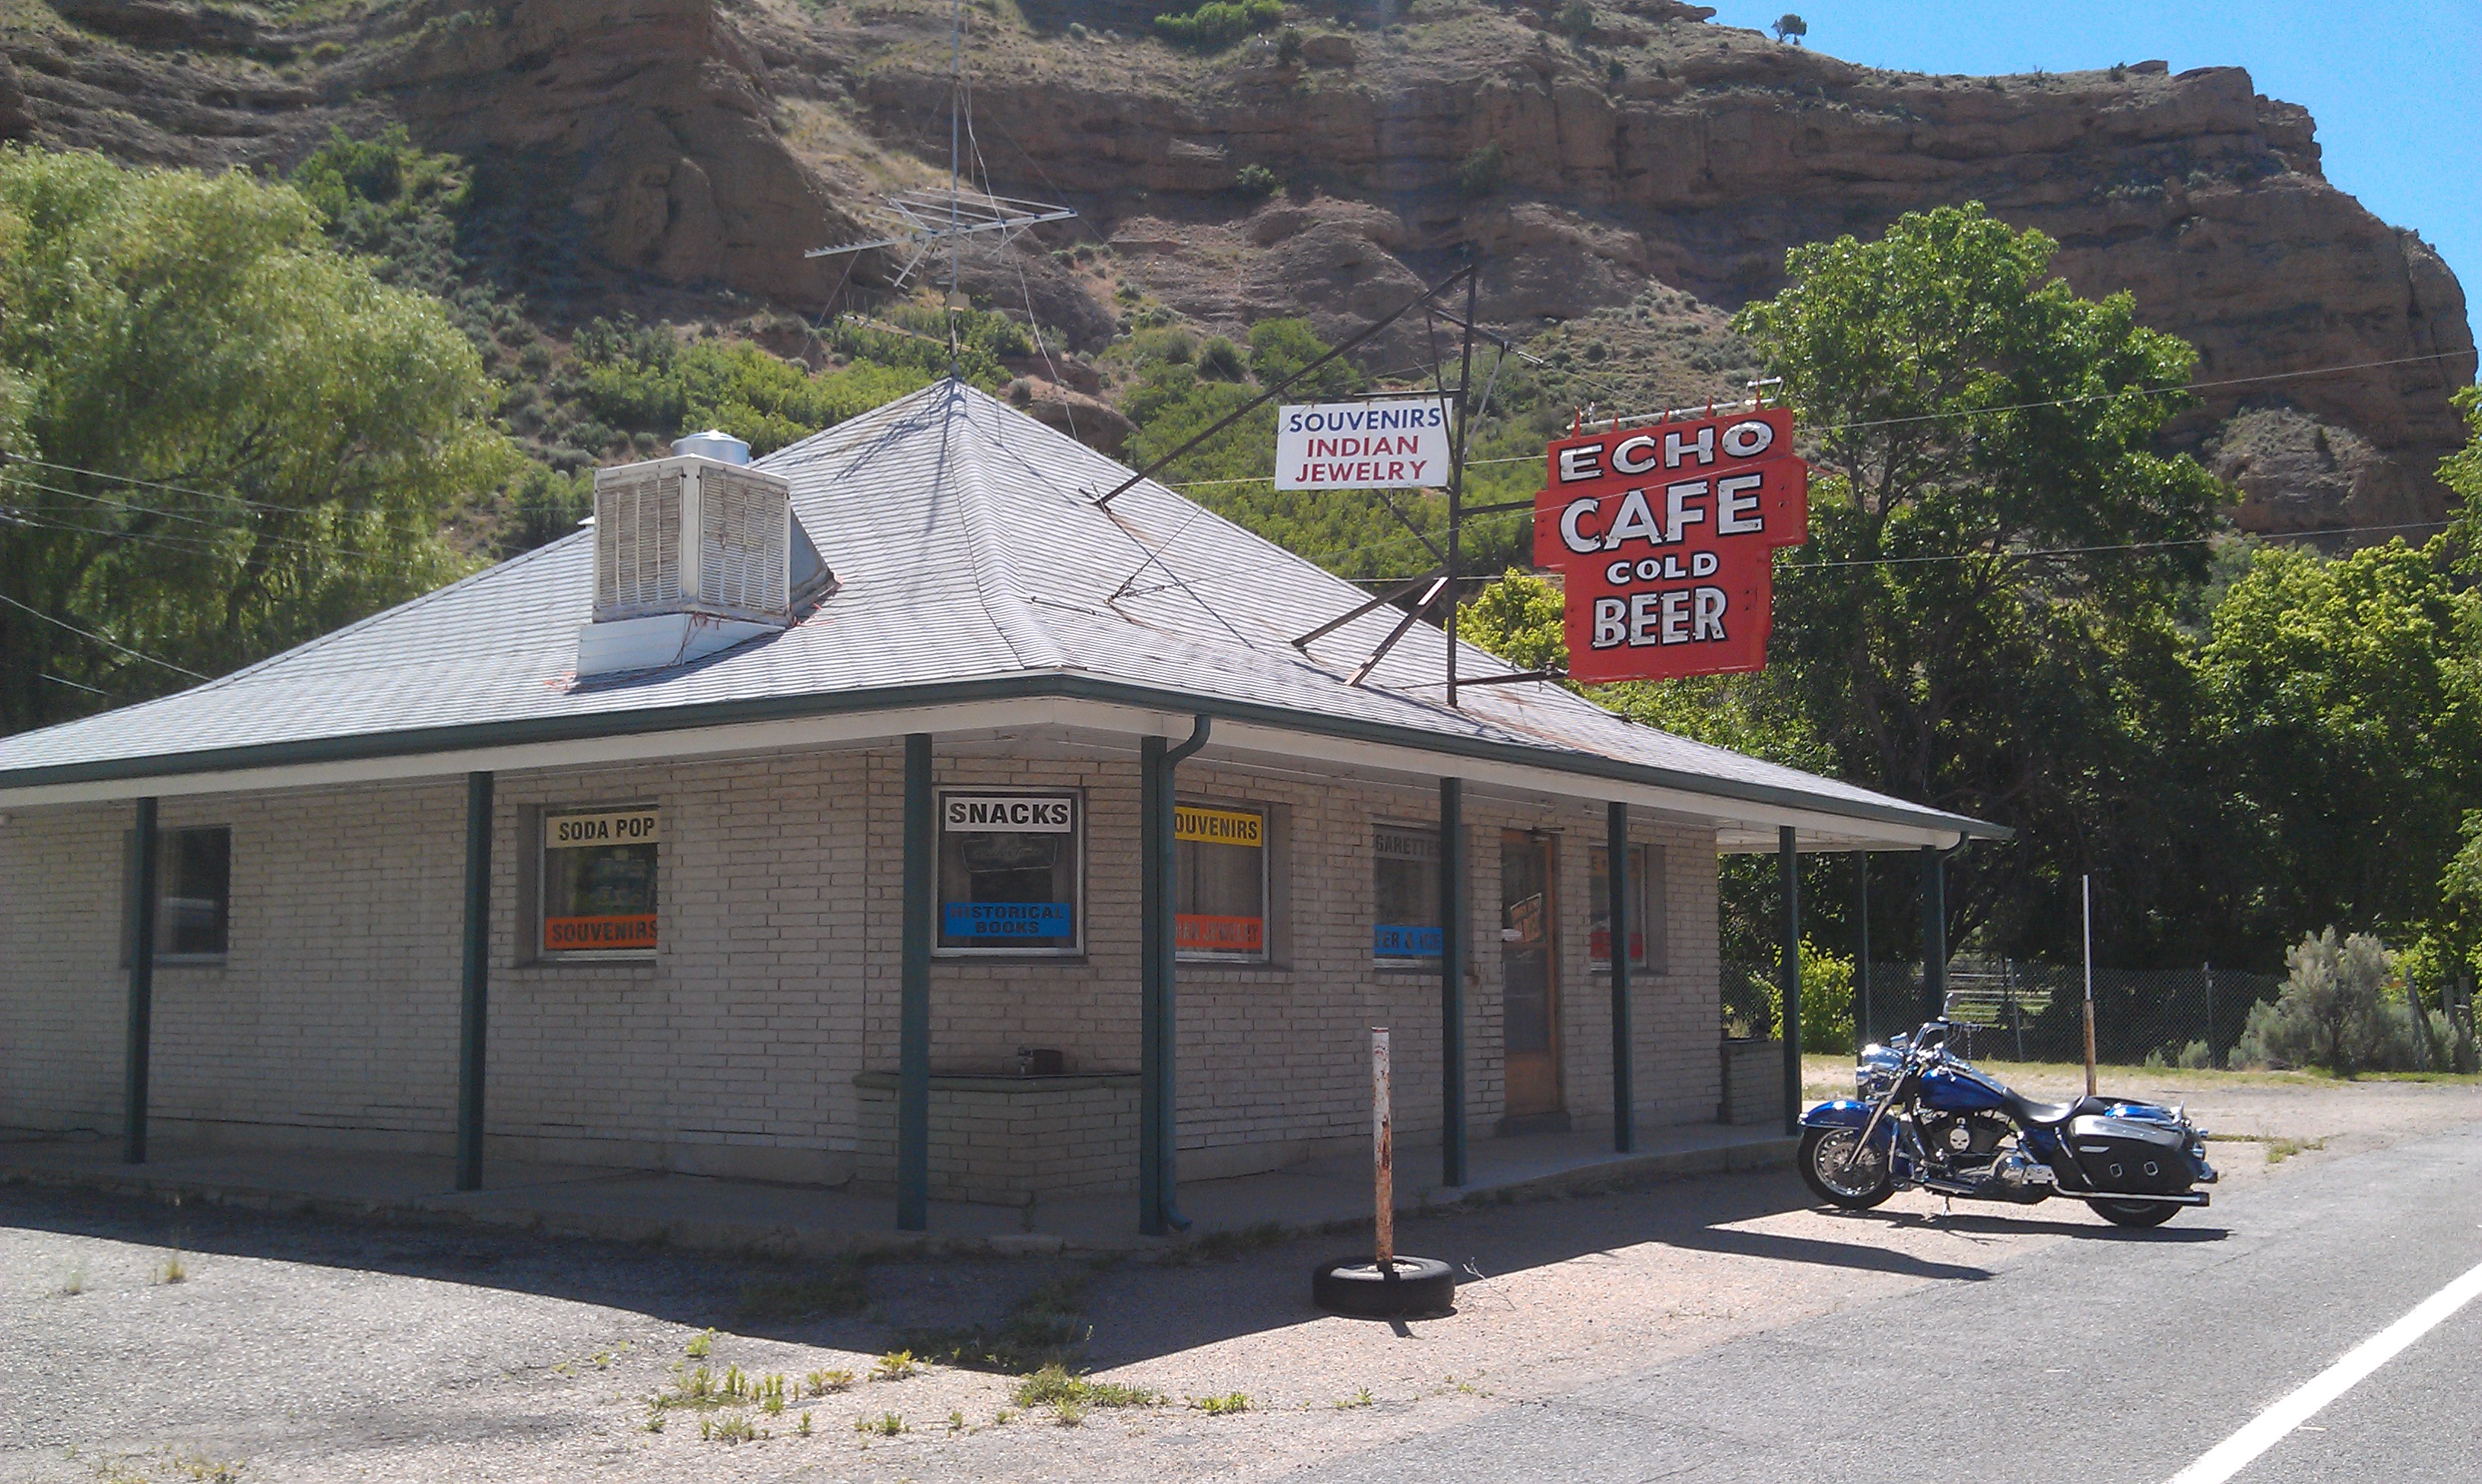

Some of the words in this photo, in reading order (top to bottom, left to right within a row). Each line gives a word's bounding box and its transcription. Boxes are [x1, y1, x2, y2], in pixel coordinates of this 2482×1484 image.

[1289, 407, 1441, 434] SOUVENIRS
[1307, 436, 1419, 457] INDIAN
[1559, 420, 1774, 483] ECHO
[1295, 460, 1427, 483] JEWELRY
[1560, 473, 1764, 553] CAFE
[1605, 552, 1719, 585] COLD
[1592, 586, 1728, 650] BEER
[949, 803, 1068, 825] SNACKS
[559, 820, 608, 840] SODA
[616, 817, 655, 838] POP
[1175, 813, 1258, 840] OUVENIRS
[951, 905, 1064, 919] HISTORICAL
[552, 920, 657, 943] SOUVENIRS
[975, 921, 1039, 934] BOOKS
